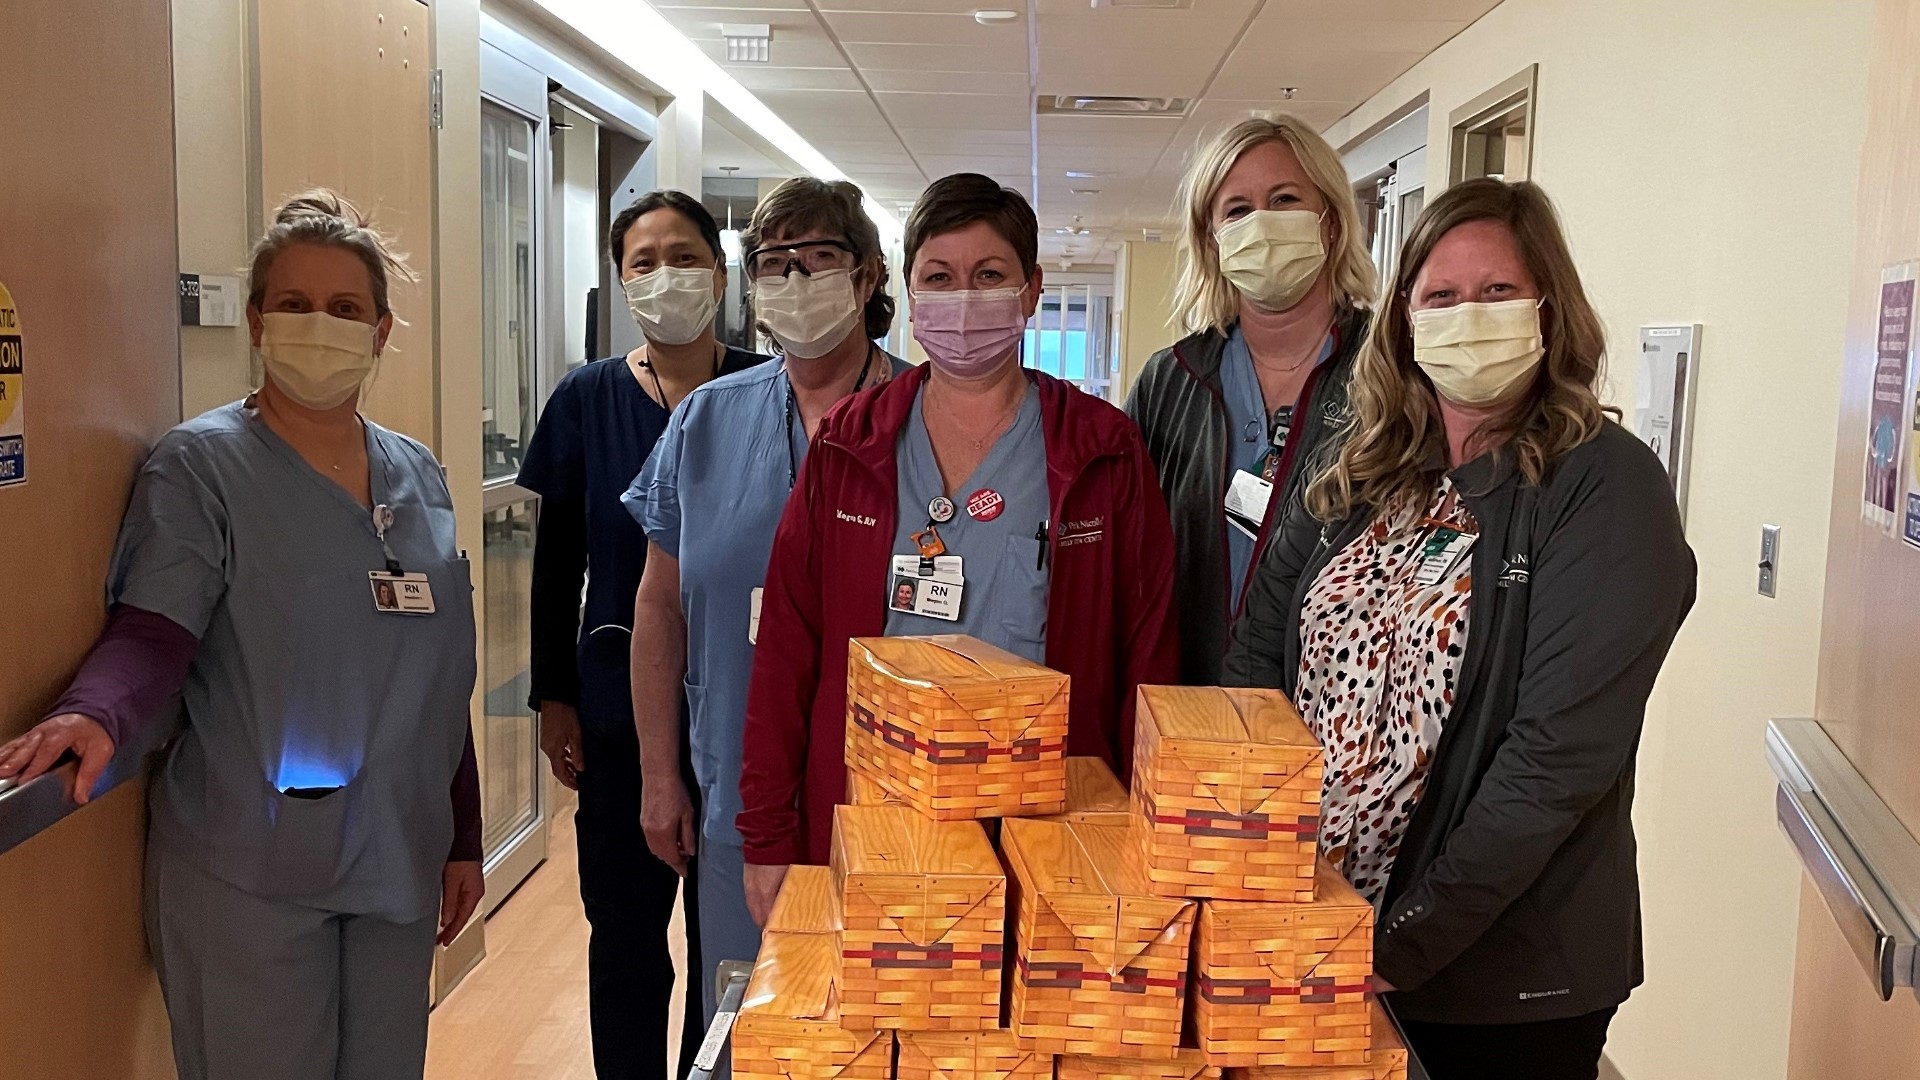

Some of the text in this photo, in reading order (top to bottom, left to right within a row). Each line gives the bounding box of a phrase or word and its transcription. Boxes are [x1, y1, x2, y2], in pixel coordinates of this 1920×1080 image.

[970, 494, 999, 513] READY
[404, 584, 419, 593] RN
[930, 585, 948, 597] RN
